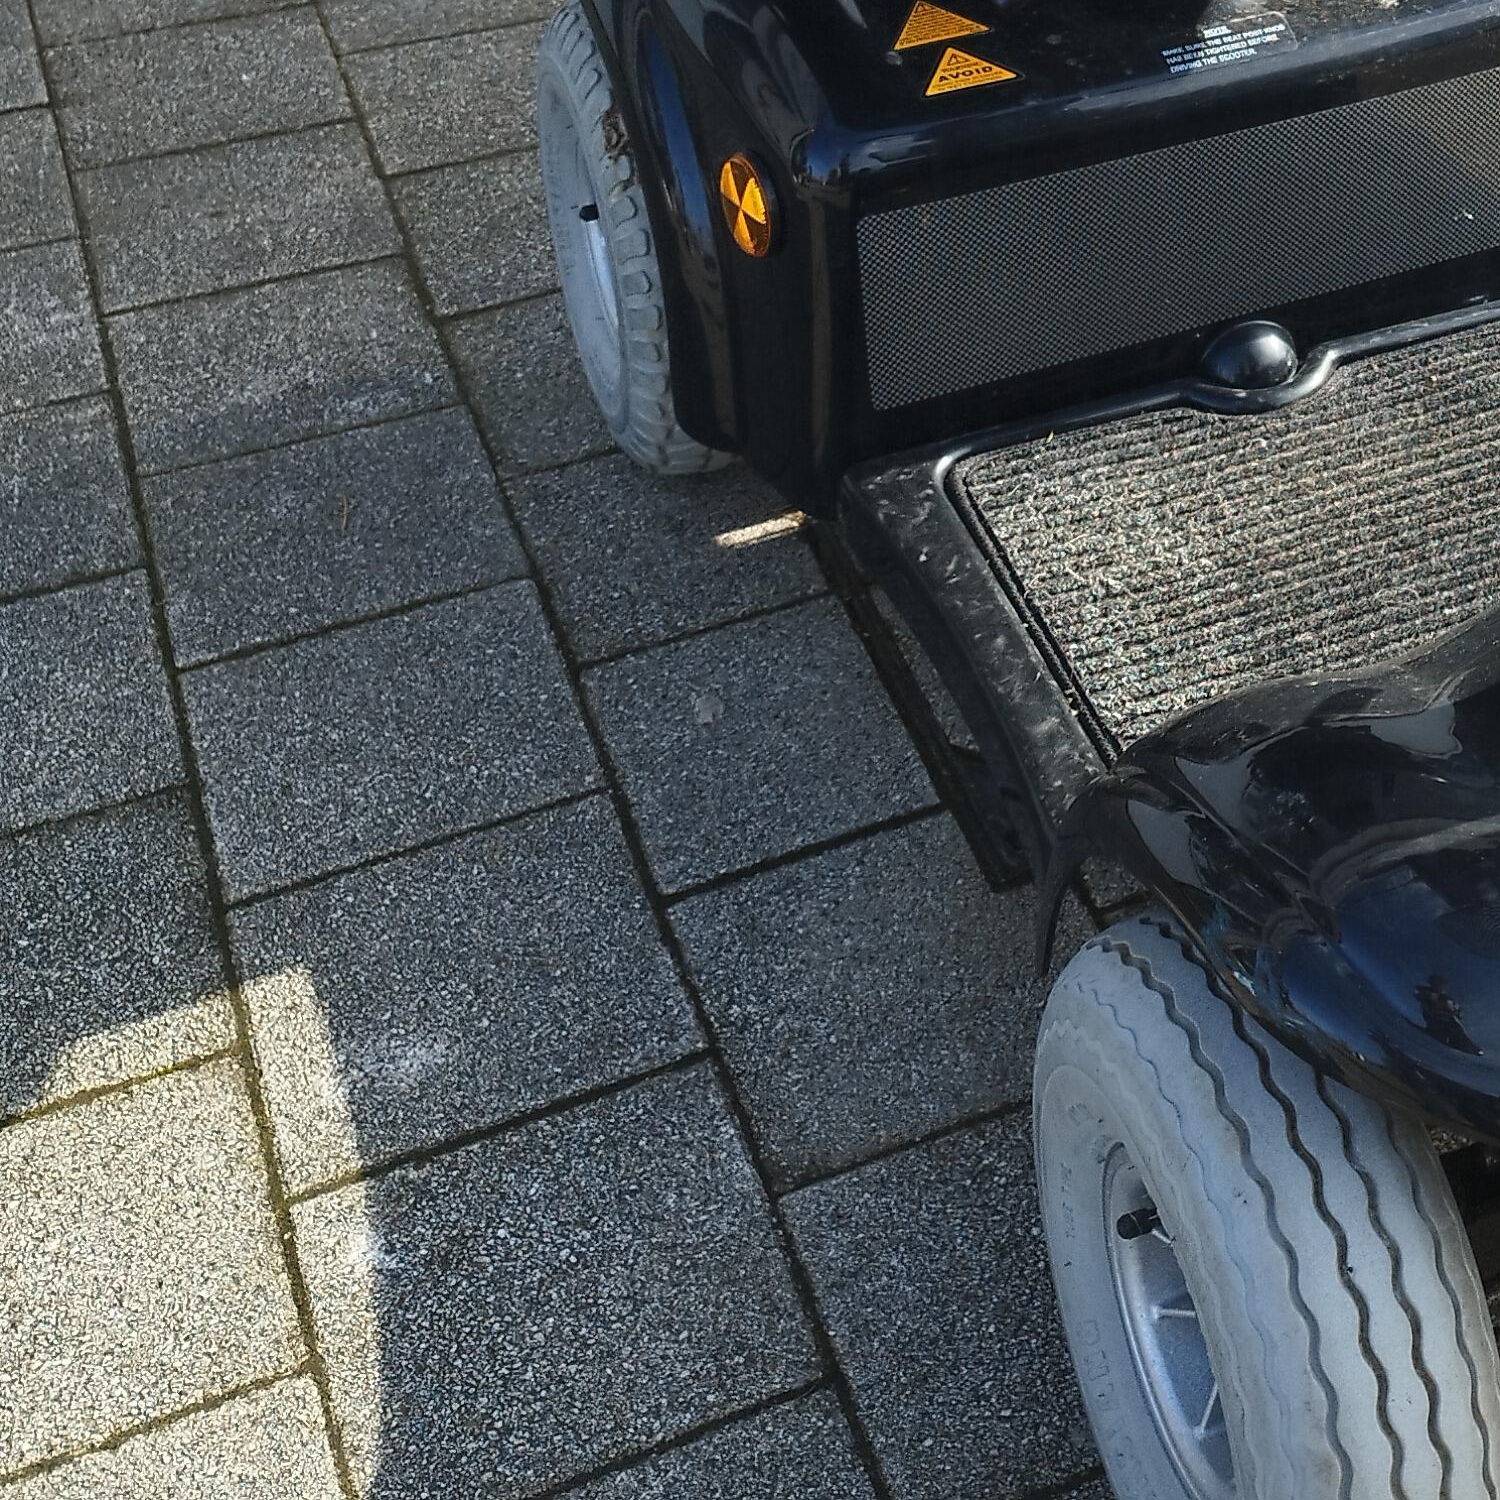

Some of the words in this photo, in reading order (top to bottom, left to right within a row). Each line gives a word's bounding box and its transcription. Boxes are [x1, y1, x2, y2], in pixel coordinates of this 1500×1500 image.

[1205, 41, 1247, 56] TIGHTENED
[1206, 37, 1222, 47] THE
[1170, 60, 1202, 74] DRIVING
[1202, 55, 1218, 66] THE
[939, 66, 993, 83] AVOID
